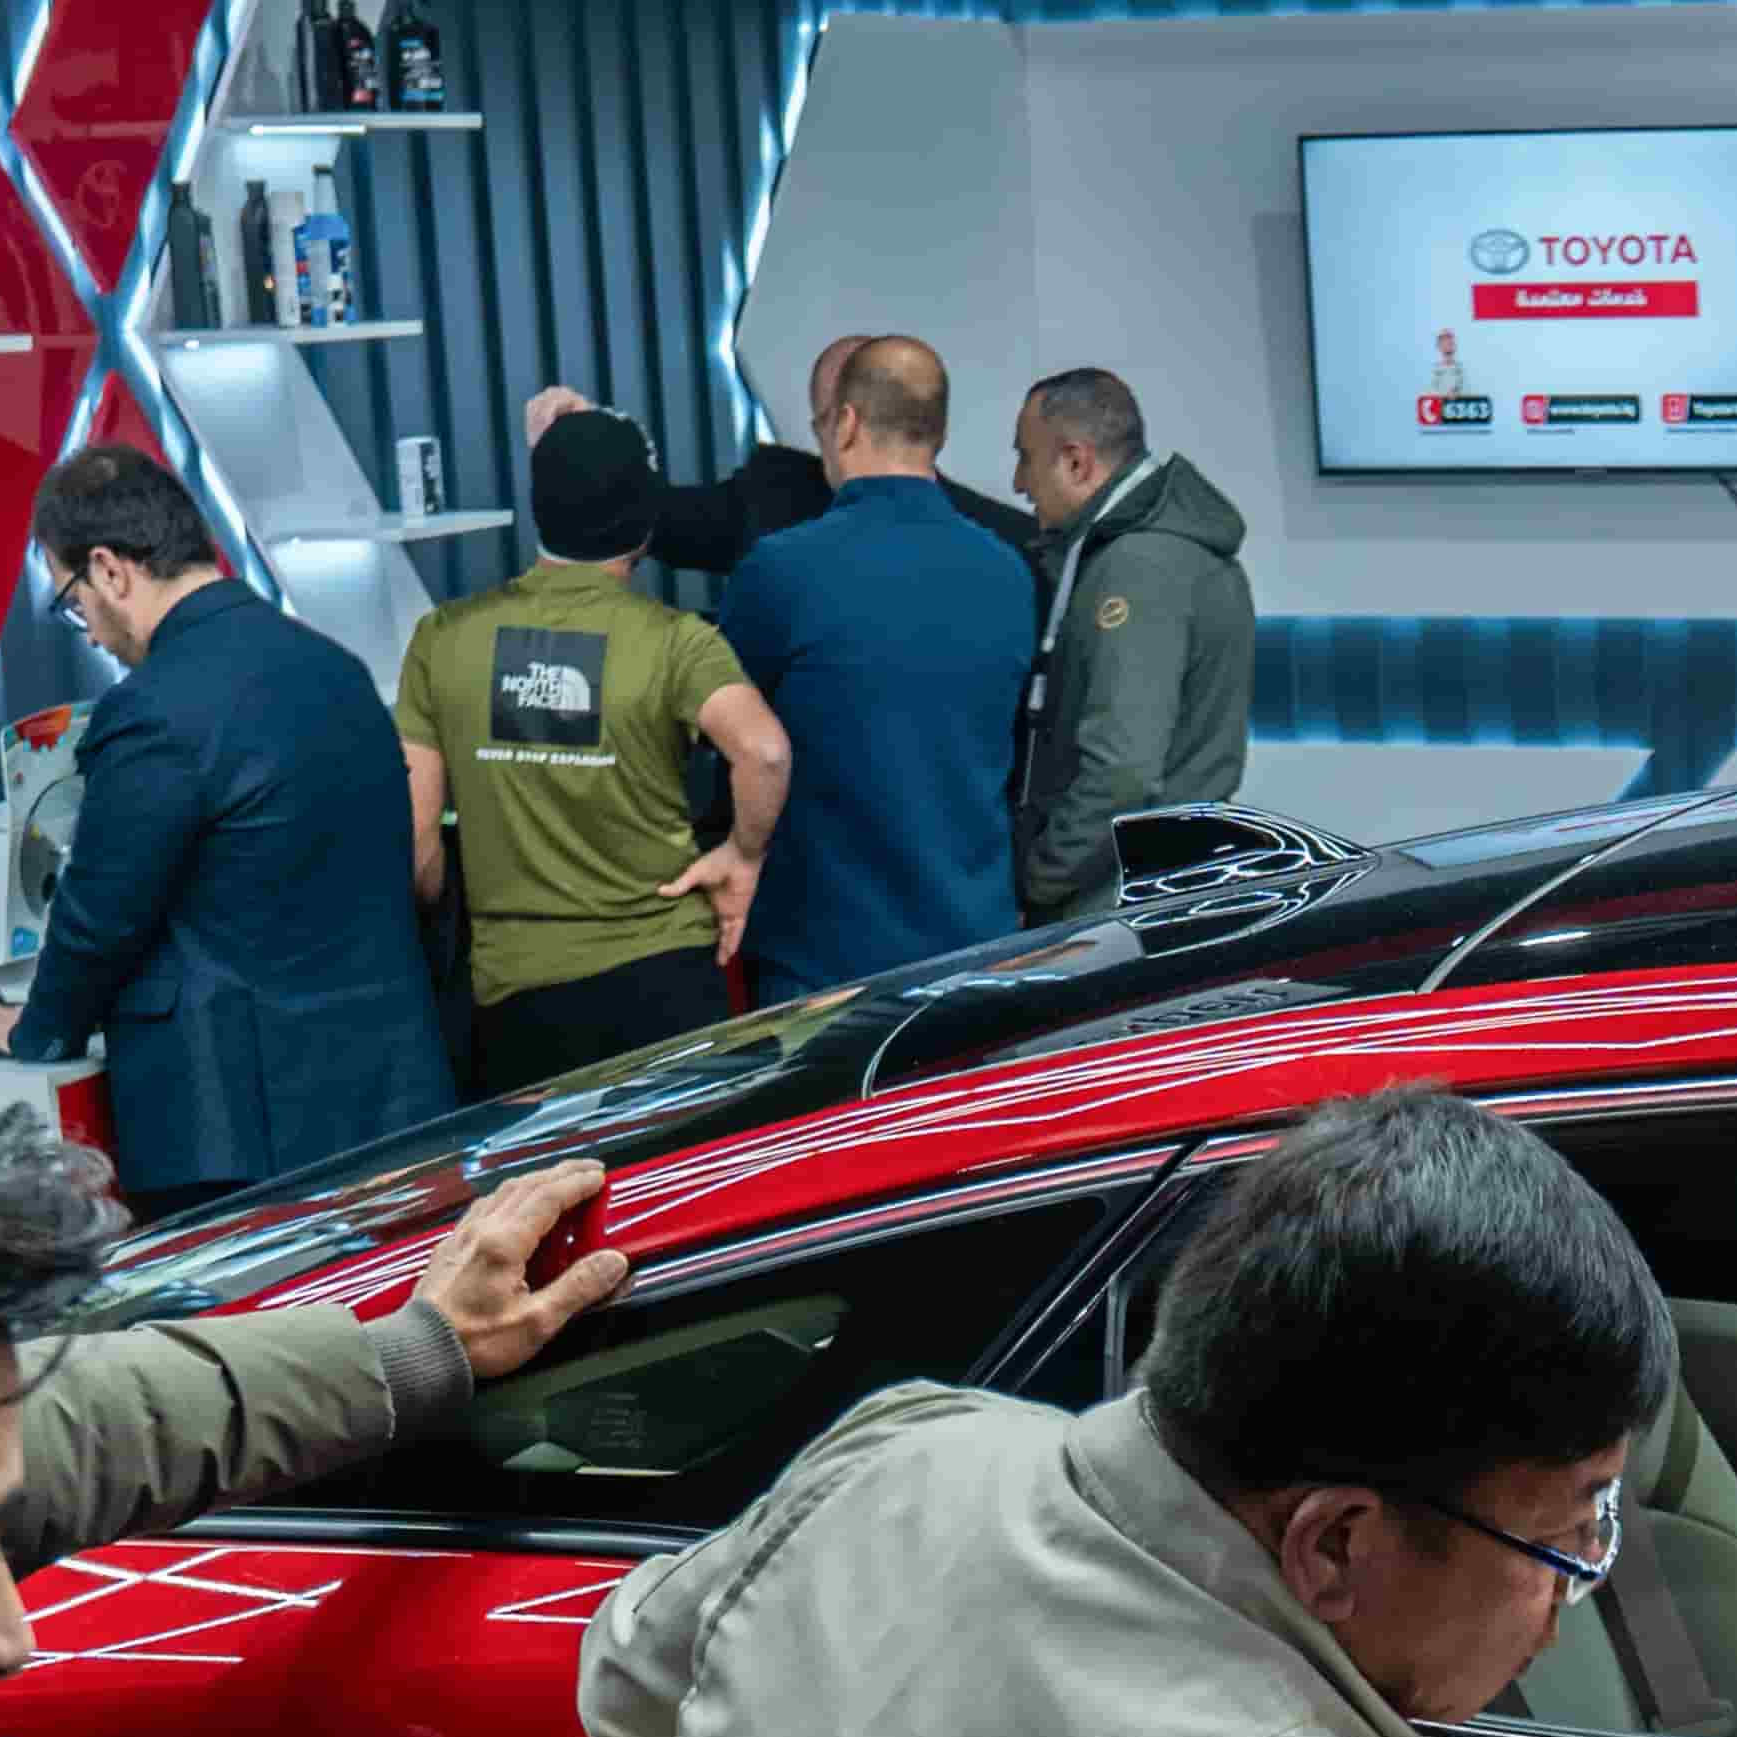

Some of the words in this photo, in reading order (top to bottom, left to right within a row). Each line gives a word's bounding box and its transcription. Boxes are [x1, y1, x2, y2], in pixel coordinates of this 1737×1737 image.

[1538, 234, 1698, 266] TOYOTA
[1444, 402, 1489, 419] 6363
[527, 660, 563, 678] THE
[502, 674, 561, 697] NORTH
[517, 694, 562, 711] FACE
